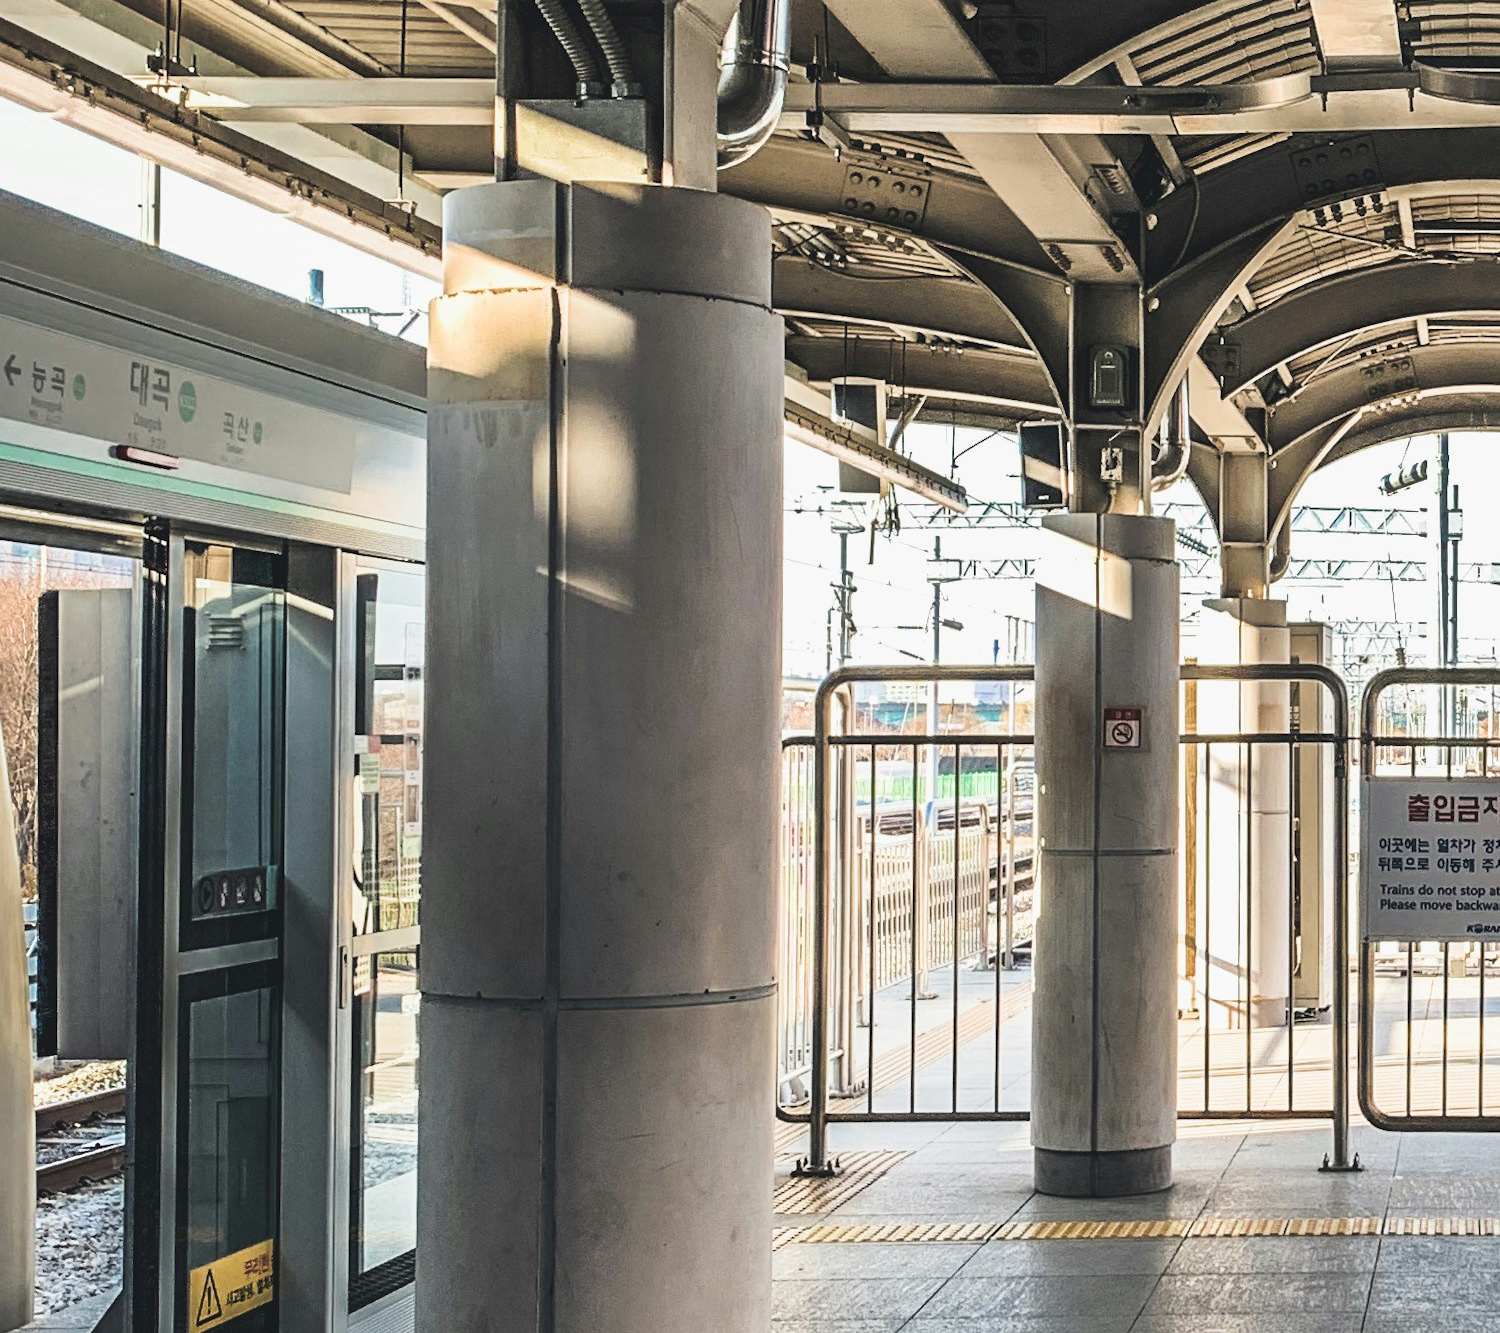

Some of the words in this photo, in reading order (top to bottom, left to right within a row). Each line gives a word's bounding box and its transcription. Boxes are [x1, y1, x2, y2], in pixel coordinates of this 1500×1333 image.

[32, 360, 66, 398] 능곡
[129, 361, 171, 412] 대곡
[222, 411, 250, 443] 곡산
[1378, 837, 1430, 853] 이곳에는
[1437, 838, 1476, 854] 열차가
[1378, 857, 1430, 873] 뒤쪽으로
[1437, 858, 1475, 874] 이동해
[1380, 884, 1415, 896] Trains
[1418, 884, 1434, 896] do
[1437, 885, 1457, 896] not
[1460, 886, 1486, 899] stop
[1489, 886, 1500, 897] at
[1380, 899, 1416, 910] Please
[1420, 901, 1453, 911] move
